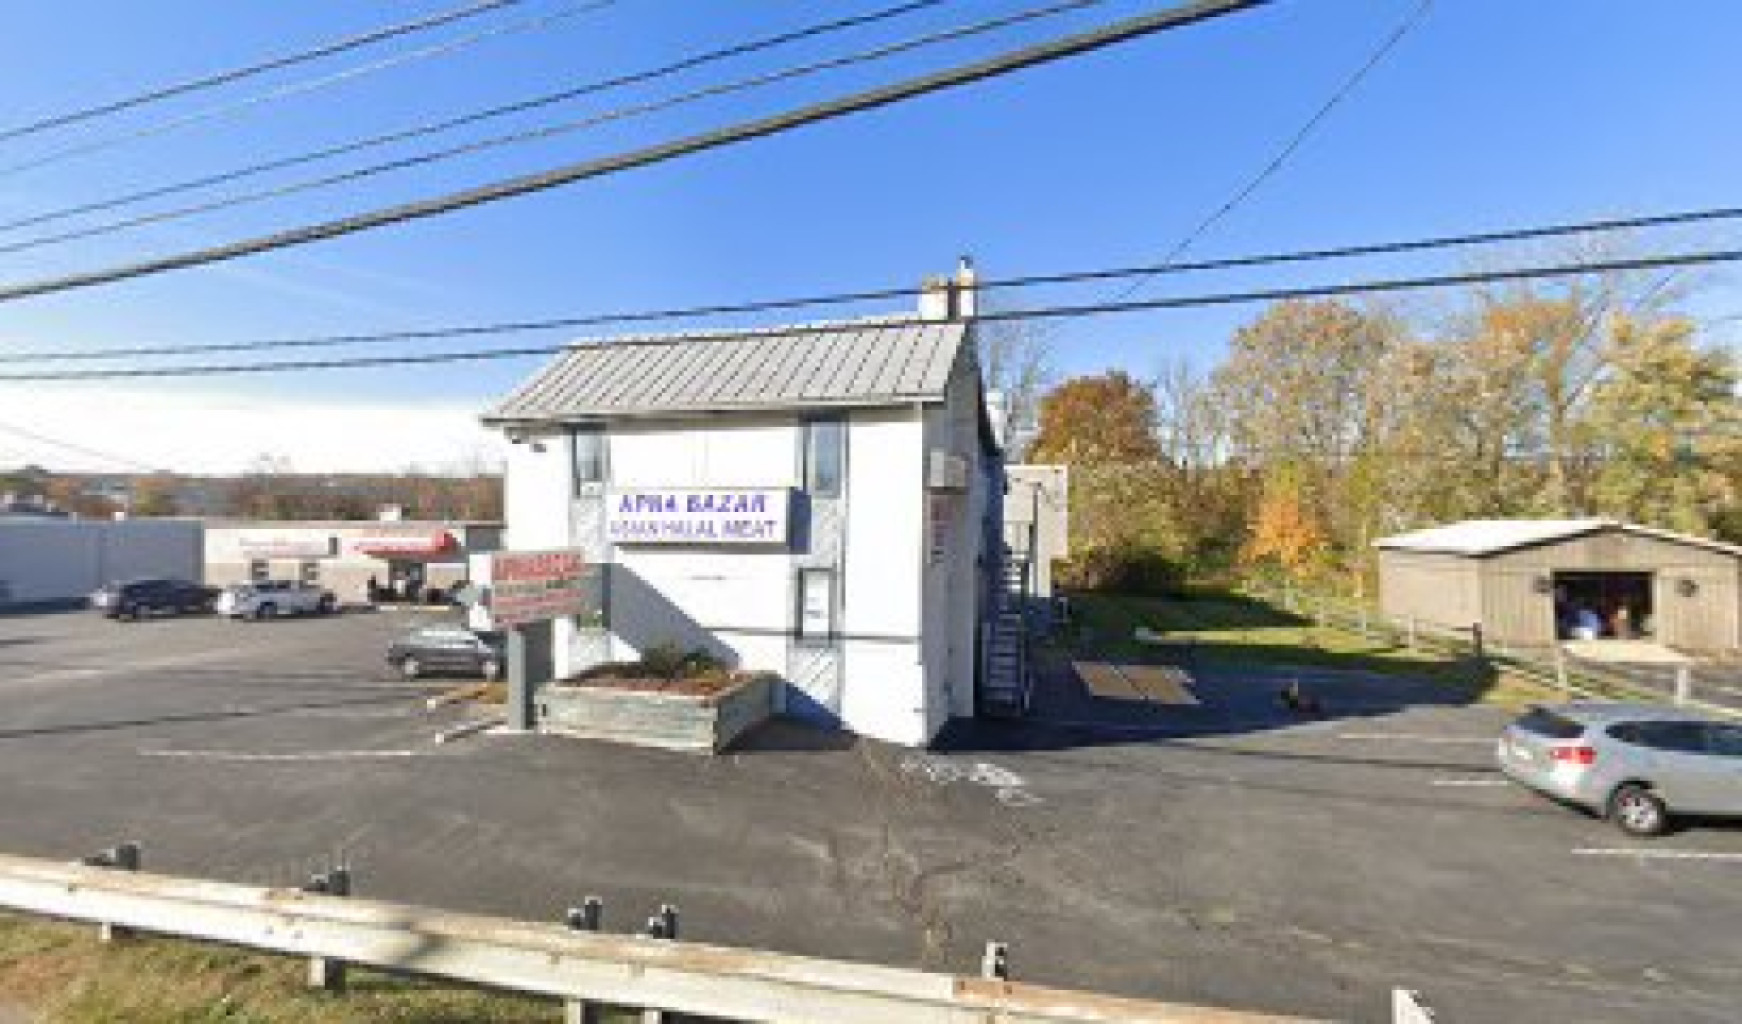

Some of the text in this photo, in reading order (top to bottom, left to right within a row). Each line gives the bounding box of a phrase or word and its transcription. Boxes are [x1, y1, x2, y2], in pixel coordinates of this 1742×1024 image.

[618, 494, 767, 513] APNA BAZAR
[661, 519, 718, 538] HALAL
[721, 519, 777, 538] MEAT
